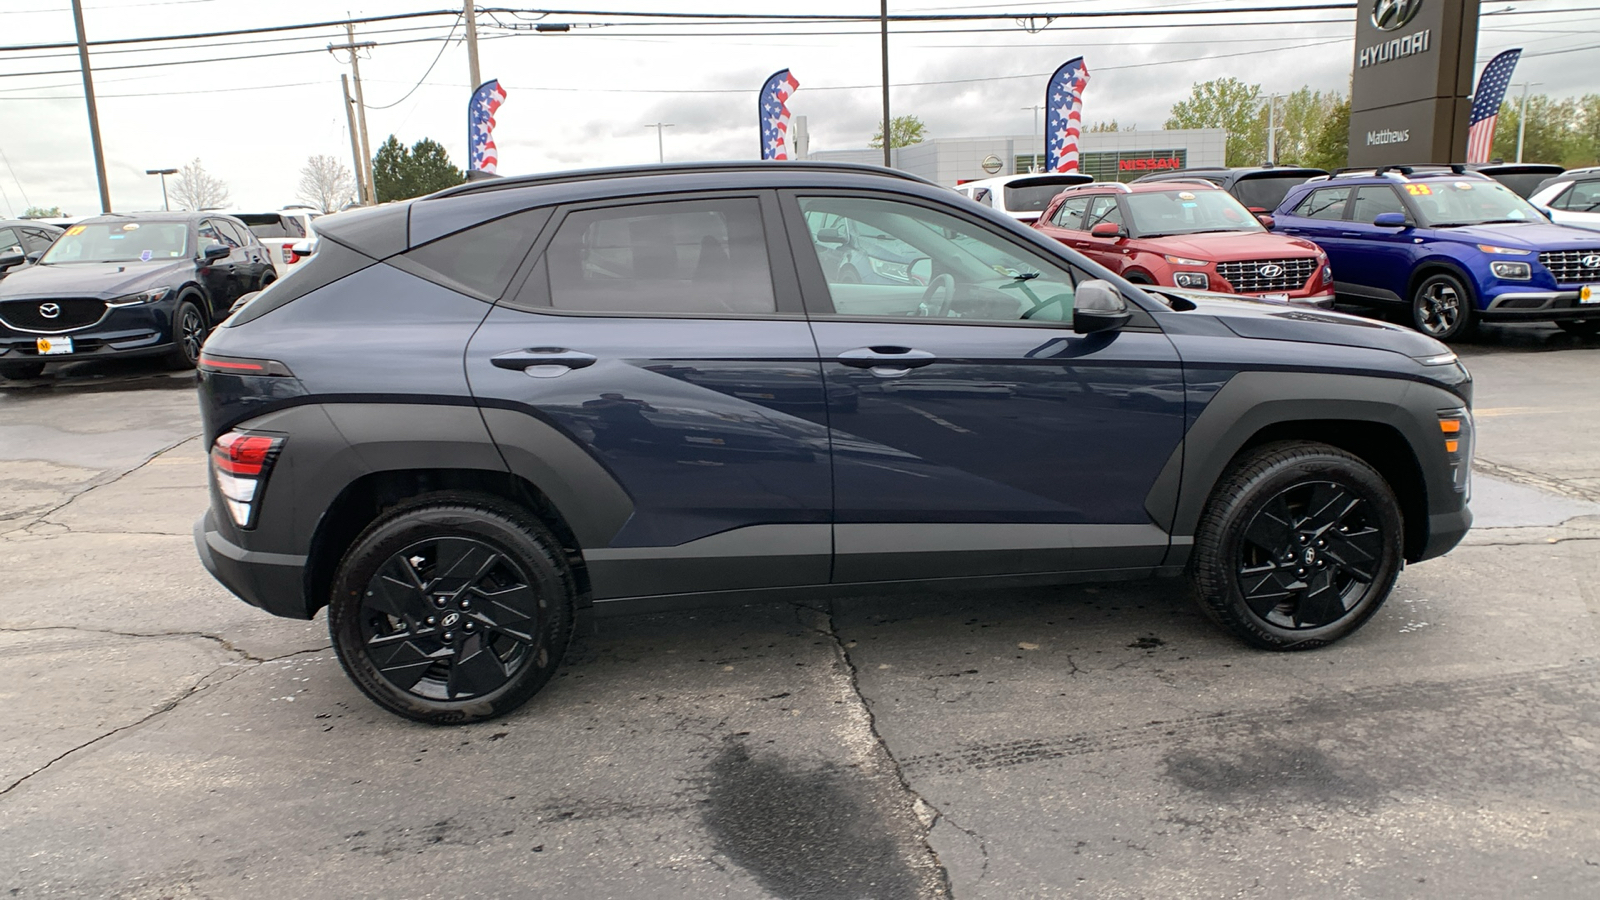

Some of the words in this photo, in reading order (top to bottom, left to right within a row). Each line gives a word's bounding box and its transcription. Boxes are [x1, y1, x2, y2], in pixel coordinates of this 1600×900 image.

[1360, 29, 1431, 68] HYUNDAI
[1366, 128, 1410, 146] Matthews
[1119, 157, 1180, 171] NISSAN
[1405, 183, 1430, 196] 23
